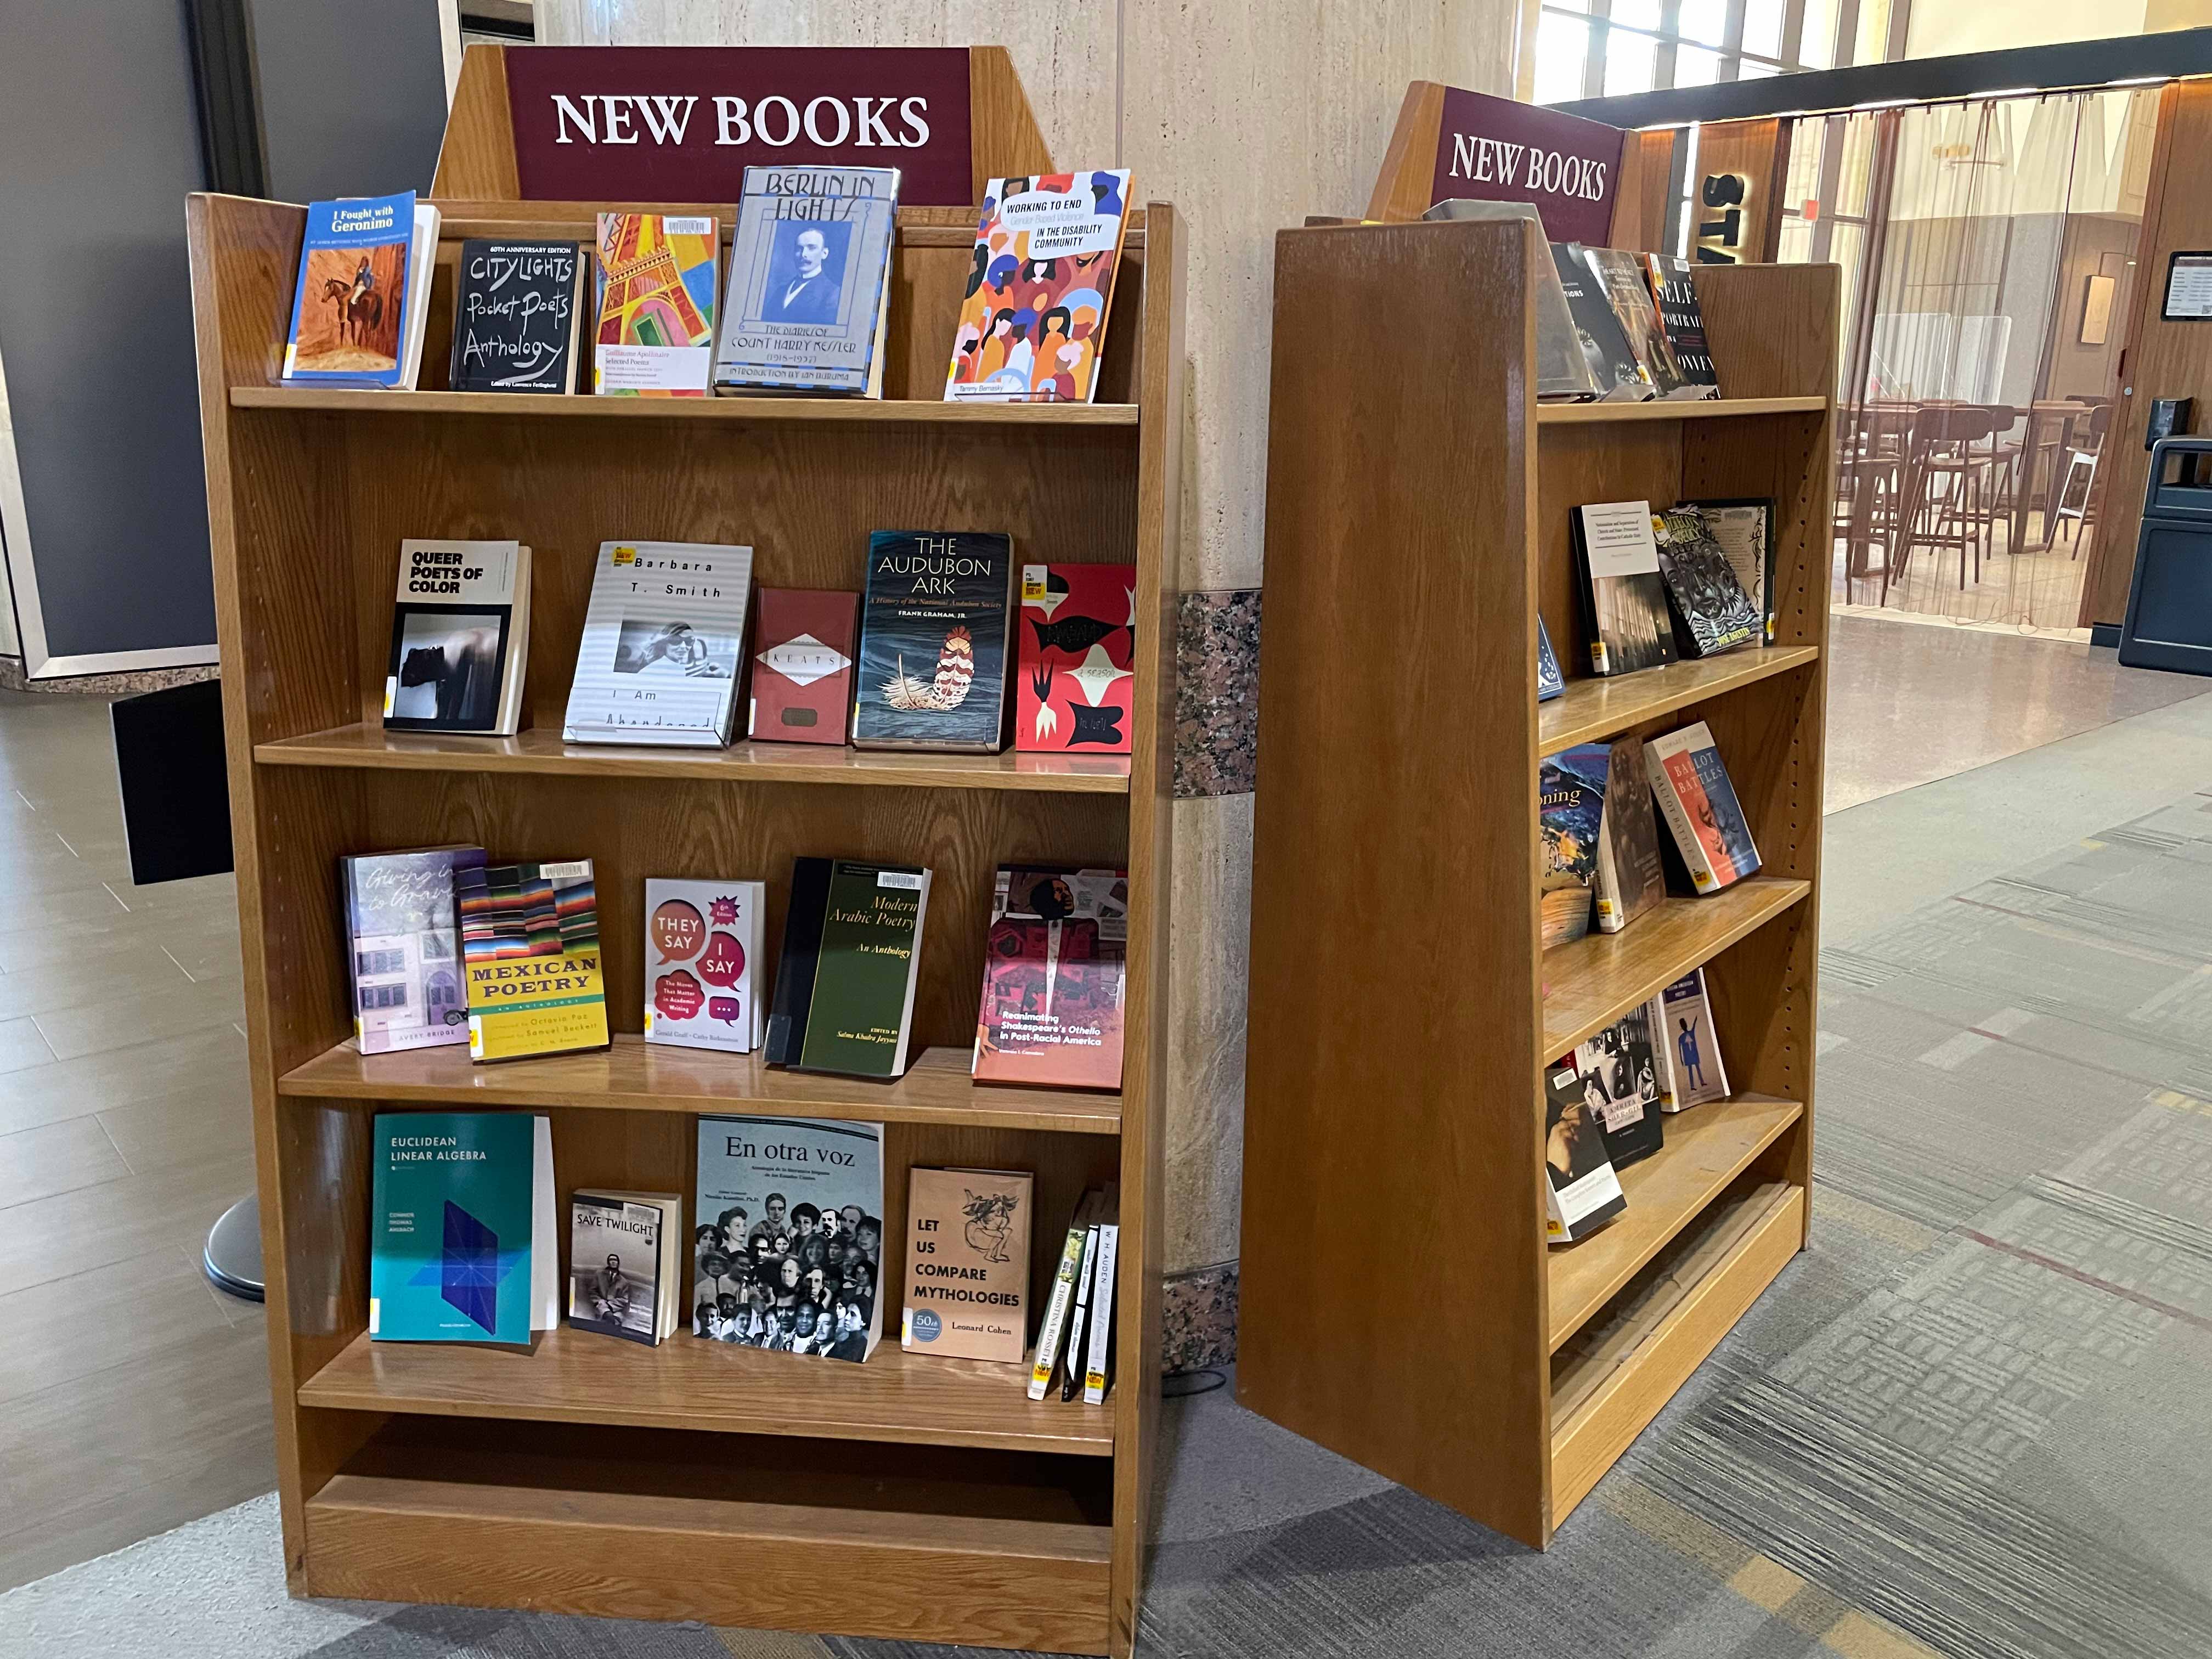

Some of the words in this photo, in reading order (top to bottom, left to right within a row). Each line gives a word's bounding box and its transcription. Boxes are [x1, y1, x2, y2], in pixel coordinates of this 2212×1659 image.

[551, 95, 699, 145] NEW
[712, 95, 930, 148] BOOKS
[1449, 133, 1525, 185] NEW
[1525, 148, 1606, 201] BOOKS
[765, 173, 844, 196] BERLIN
[852, 177, 875, 199] IN
[334, 211, 338, 220] I
[341, 208, 372, 220] Fought
[375, 205, 394, 217] with
[775, 195, 859, 222] LIGHTS
[1007, 201, 1047, 213] WORKING
[1051, 201, 1061, 211] TO
[1064, 199, 1082, 209] END
[332, 217, 393, 232] Geronimo
[1037, 228, 1045, 238] IN
[1046, 227, 1059, 236] THE
[1062, 224, 1102, 235] DISABILITY
[1035, 236, 1084, 249] COMMUNITY
[1564, 289, 1584, 298] TIONS
[467, 292, 521, 323] Pocket
[520, 288, 568, 336] Poets
[731, 337, 774, 350] COUNT
[774, 339, 811, 352] HARRY
[464, 328, 563, 383] Anthology
[914, 537, 957, 556] THE
[411, 551, 463, 566] QUEER
[635, 557, 712, 572] Barbara
[410, 567, 461, 579] POETS
[463, 568, 483, 580] OF
[877, 556, 991, 577] AUDUBON
[409, 580, 461, 594] COLOR
[665, 584, 720, 597] Smith
[911, 577, 956, 595] ARK
[774, 653, 835, 665] KEATS
[613, 690, 616, 698] I
[634, 690, 657, 700] Am
[1674, 752, 1714, 777] BALLOT
[1678, 765, 1724, 794] BATTLES
[870, 895, 918, 912] Modern
[658, 917, 699, 933] THEY
[829, 908, 872, 924] Arabic
[876, 912, 916, 933] Poetry
[664, 935, 693, 949] SAY
[718, 943, 723, 956] I
[856, 943, 870, 952] An
[871, 945, 911, 959] Anthology
[472, 958, 597, 982] MEXICAN
[706, 959, 735, 974] SAY
[483, 975, 589, 998] POETRY
[1002, 1010, 1059, 1025] Reanimating
[1001, 1021, 1066, 1034] Shakespeare's
[1068, 1025, 1102, 1036] Othello
[1010, 1031, 1062, 1044] Post-Racial
[1063, 1036, 1102, 1047] America
[391, 1136, 457, 1147] EUCLIDEAN
[391, 1150, 433, 1161] LINEAR
[436, 1150, 487, 1161] ALGEBRA
[724, 1136, 757, 1158] En
[764, 1142, 808, 1162] otra
[816, 1148, 856, 1167] voz
[577, 1214, 602, 1227] SAVE
[605, 1217, 654, 1237] TWILIGHT
[917, 1218, 940, 1232] LET
[916, 1240, 935, 1254] US
[915, 1263, 987, 1282] COMPARE
[1101, 1254, 1110, 1284] AUDEN
[913, 1285, 1020, 1307] MYTHOLOGIES
[1050, 1284, 1066, 1327] CHRISTINA
[952, 1321, 984, 1333] Leonard
[987, 1325, 1012, 1336] Cohen
